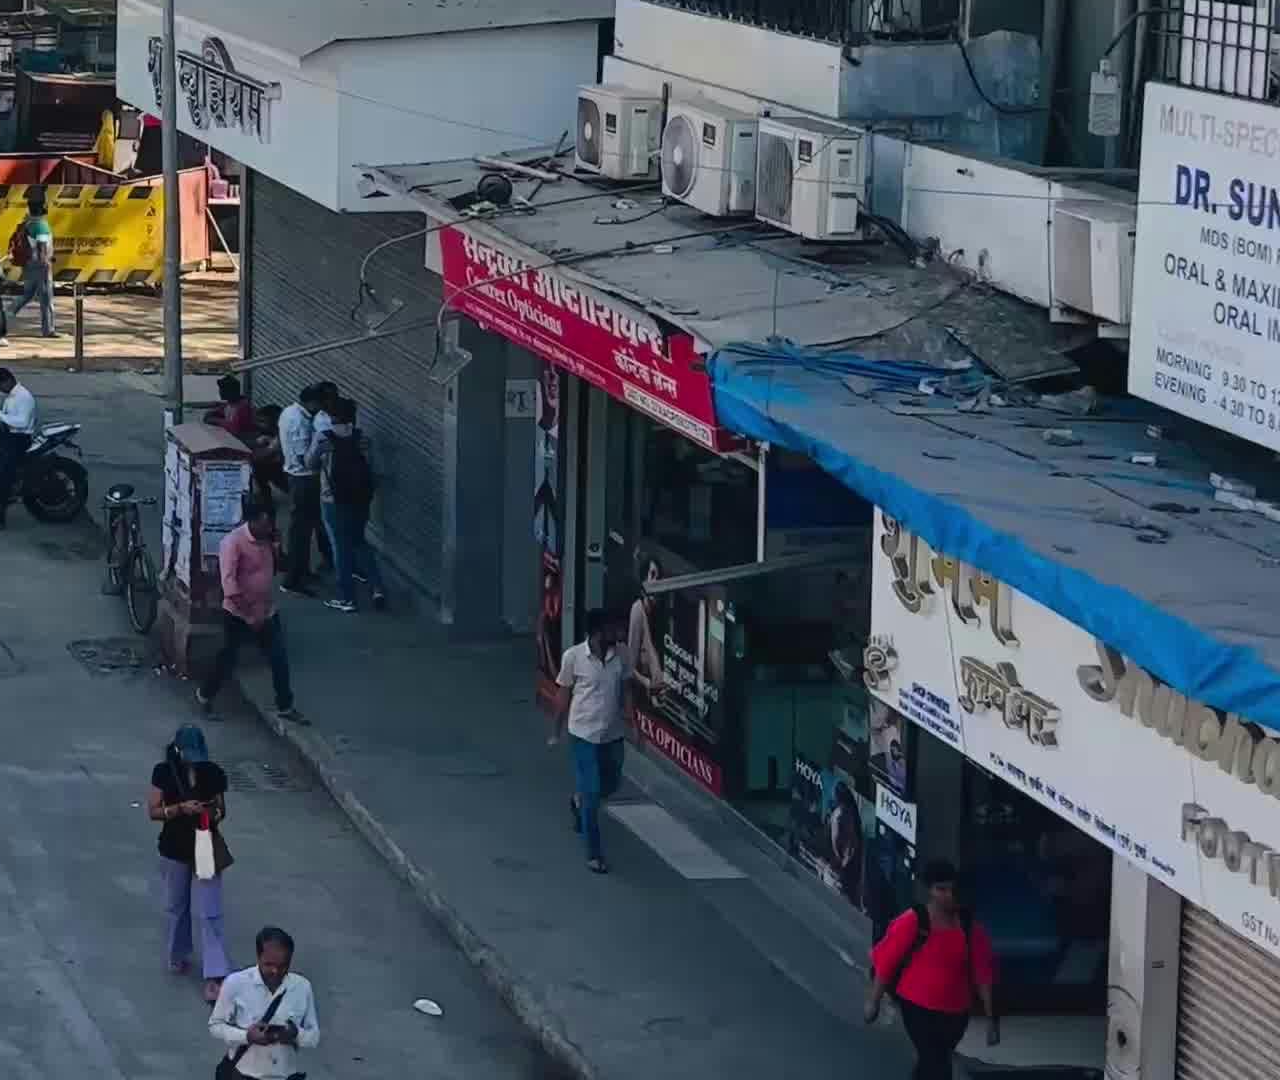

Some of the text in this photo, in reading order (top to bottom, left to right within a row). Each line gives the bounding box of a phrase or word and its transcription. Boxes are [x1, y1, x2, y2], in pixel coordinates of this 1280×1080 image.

[1175, 164, 1218, 214] DR.
[1200, 226, 1273, 265] MDS (BOM)
[1164, 253, 1210, 287] ORAL
[1214, 268, 1226, 293] &
[507, 289, 563, 337] Opticians
[1213, 302, 1263, 336] ORAL
[1155, 345, 1212, 382] MORNING
[1249, 380, 1267, 401] TO
[1154, 371, 1207, 404] EVENING
[1248, 405, 1266, 426] TO
[655, 727, 713, 785] OPTICIANS
[795, 758, 824, 790] HOYA
[881, 790, 914, 829] HOYA
[1241, 911, 1264, 935] GST
